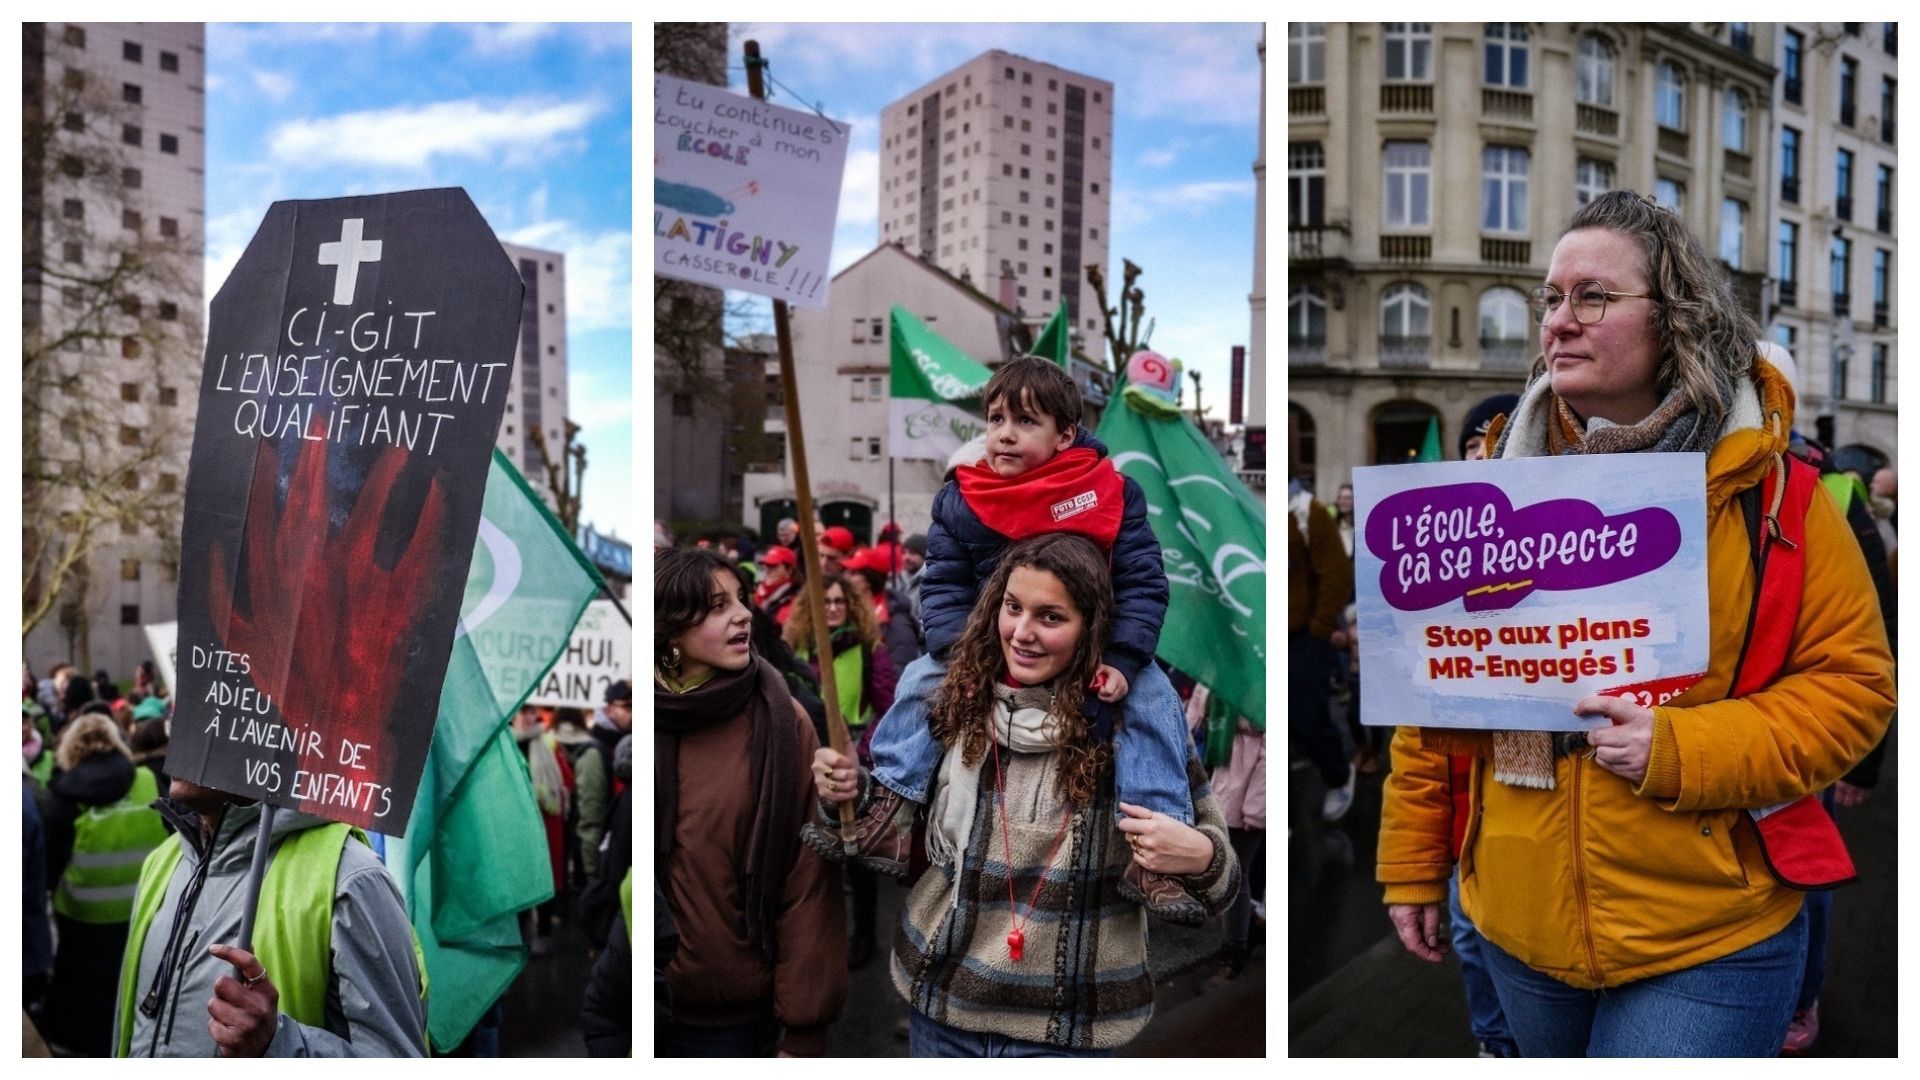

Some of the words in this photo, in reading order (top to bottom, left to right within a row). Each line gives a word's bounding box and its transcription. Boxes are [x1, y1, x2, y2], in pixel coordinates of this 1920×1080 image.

[676, 86, 703, 110] tu
[714, 103, 833, 144] continues
[655, 107, 739, 139] toucher
[749, 132, 762, 148] à
[774, 139, 821, 163] mon
[677, 128, 750, 166] ÉCOLE
[663, 250, 778, 285] CASSEROLE
[234, 399, 455, 456] QUALIFIANT
[1425, 624, 1493, 651] Stop
[1499, 625, 1551, 645] aux
[1558, 617, 1651, 649] plans
[192, 643, 251, 674] DITES
[1429, 650, 1618, 684] MR-Engagés
[1626, 648, 1636, 673] !
[205, 680, 271, 715] ADIEU
[488, 664, 592, 701] EMAIN
[204, 708, 222, 737] À
[229, 716, 325, 759] L'AVENIR
[339, 739, 371, 770] DE
[245, 758, 282, 793] VOS
[290, 770, 392, 817] ENFANTS
